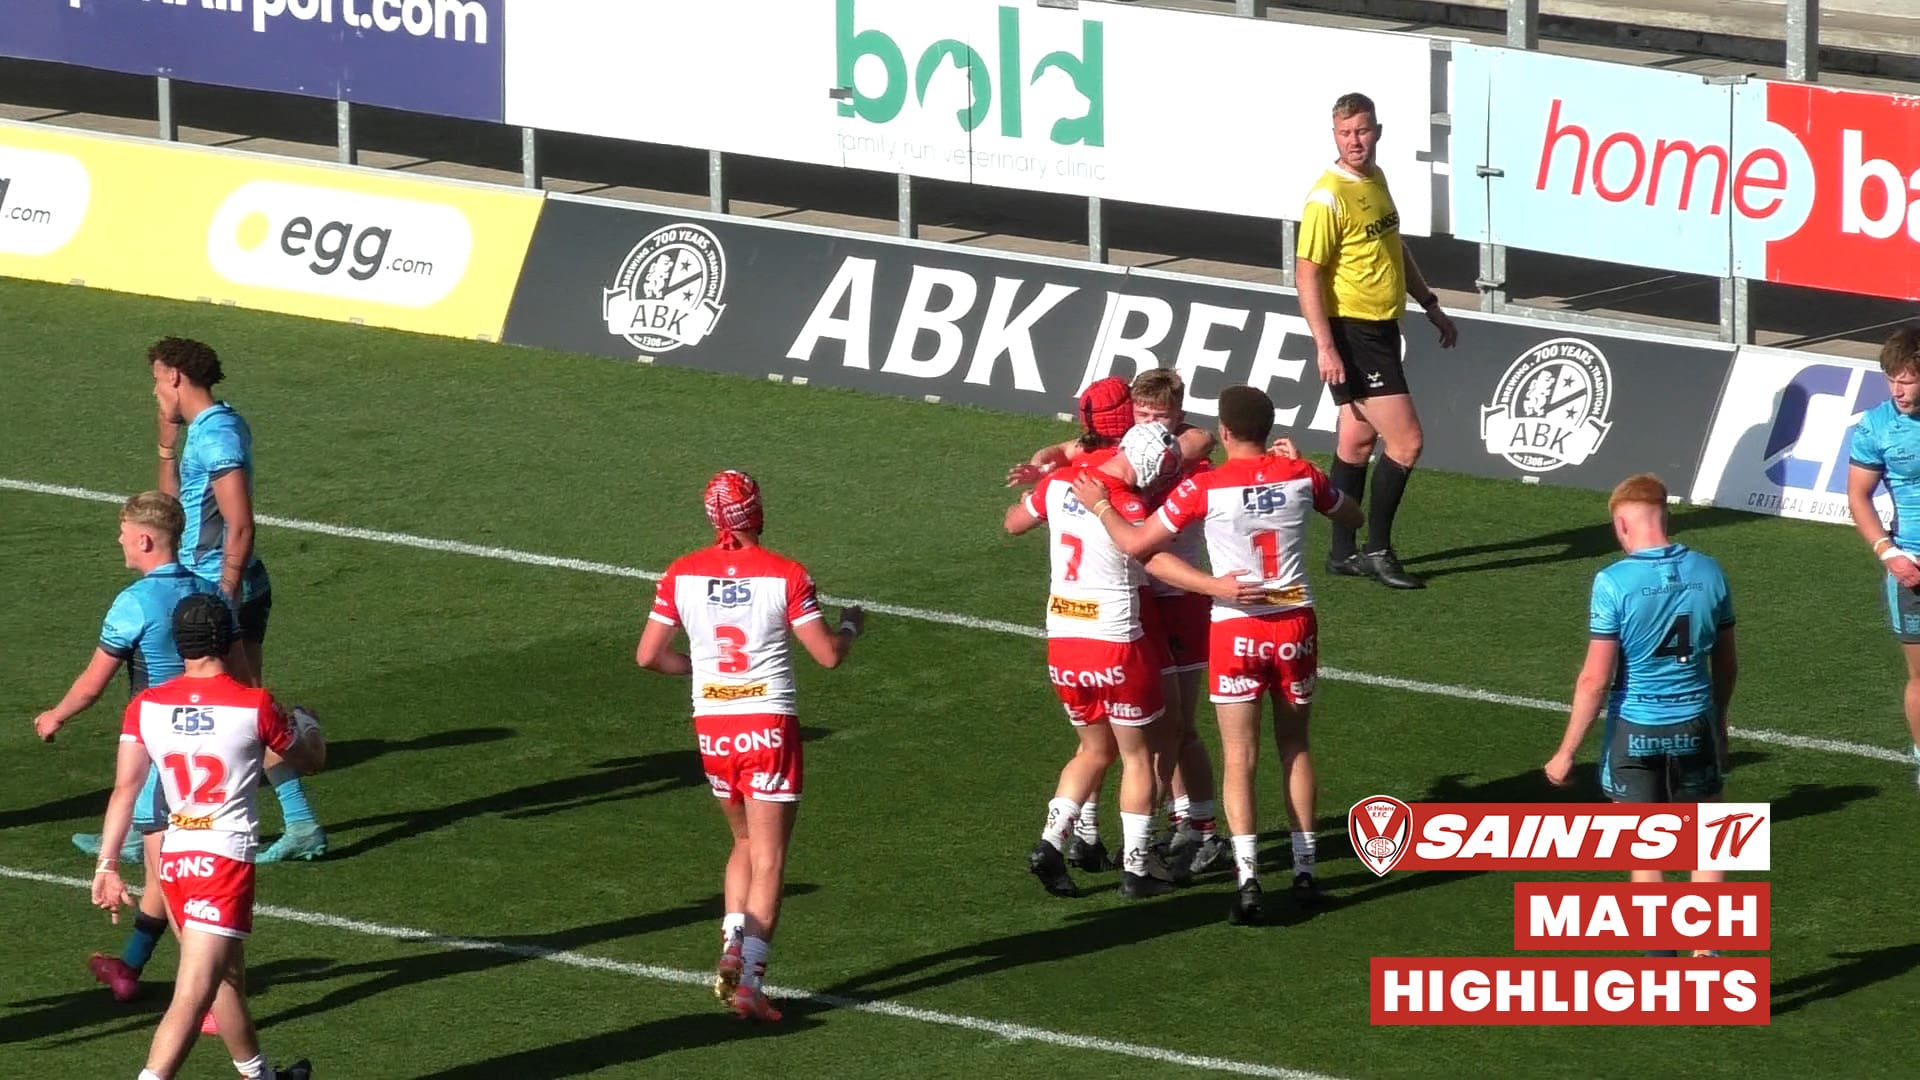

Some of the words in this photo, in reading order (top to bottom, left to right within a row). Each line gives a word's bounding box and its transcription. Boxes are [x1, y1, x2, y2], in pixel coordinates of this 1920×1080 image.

[1536, 99, 1788, 219] home
[0, 177, 51, 224] .com
[653, 230, 677, 247] 700
[679, 230, 711, 250] YEARS
[630, 304, 689, 335] ABK
[786, 255, 1080, 393] ABK
[1073, 291, 1406, 433] BEE
[1533, 345, 1558, 363] 700
[1560, 345, 1594, 366] YEARS
[1509, 422, 1573, 454] ABK
[1748, 492, 1803, 513] CRITICAL
[1060, 531, 1084, 581] 7
[1252, 529, 1280, 580] 1
[713, 623, 750, 674] 3
[1654, 611, 1695, 664] 4
[1628, 733, 1701, 749] kinetic
[162, 752, 228, 805] 12
